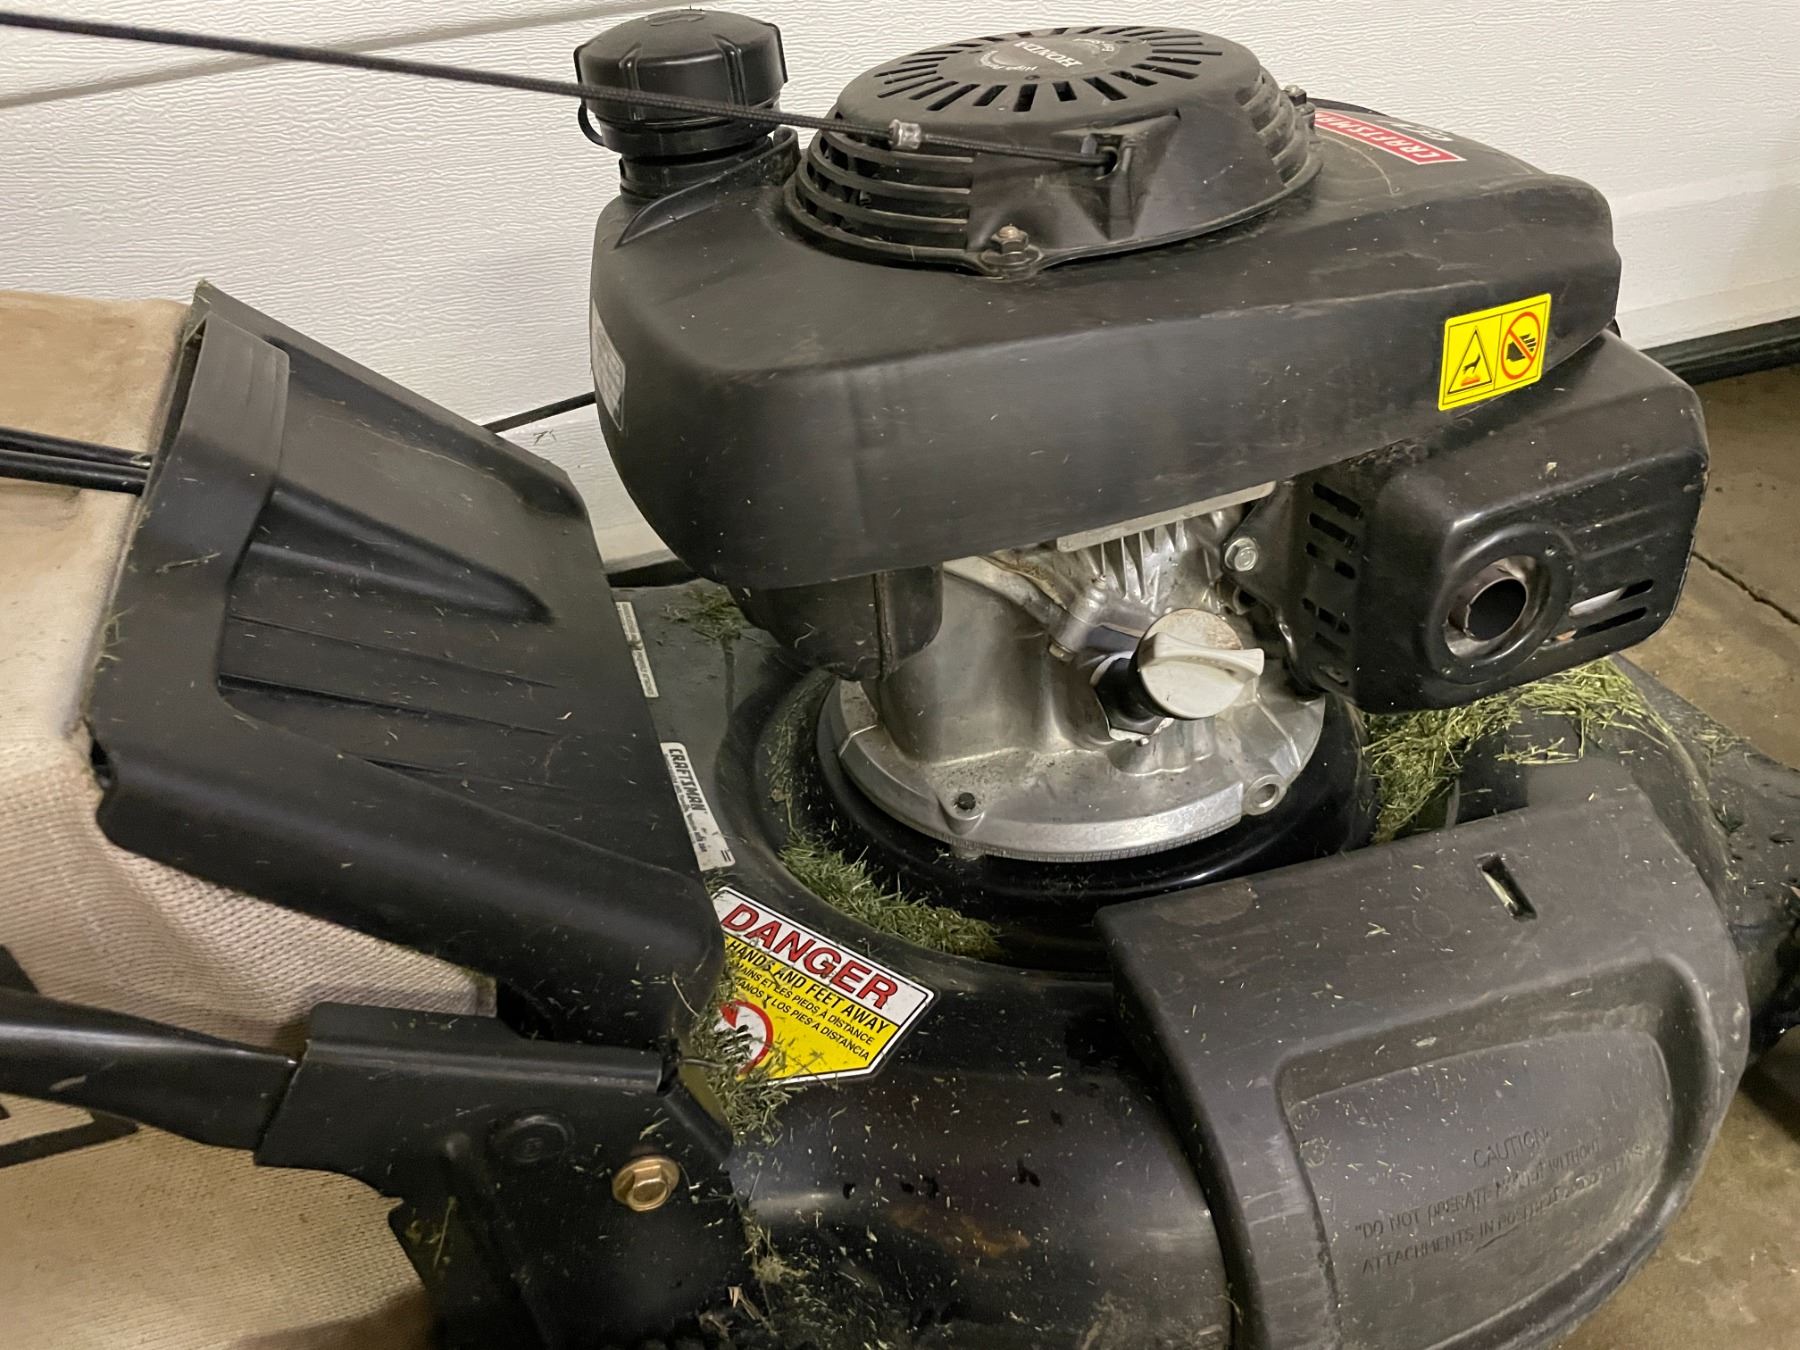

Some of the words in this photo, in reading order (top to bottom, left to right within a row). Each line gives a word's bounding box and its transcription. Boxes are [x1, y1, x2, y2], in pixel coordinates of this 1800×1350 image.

[1315, 112, 1441, 158] CRAFTSMA
[668, 747, 706, 812] CRAFTSMAN
[721, 903, 899, 1010] DANGER
[726, 940, 774, 971] HANDS
[774, 969, 806, 989] AND
[805, 983, 845, 1008] FEET
[841, 1004, 890, 1034] AWAY
[736, 979, 764, 998] ANOS
[771, 998, 792, 1013] LOS
[790, 1009, 813, 1026] PIES
[811, 1022, 821, 1031] A
[820, 1026, 870, 1062] DISTANCIA
[761, 978, 775, 988] ET
[774, 986, 793, 999] LES
[791, 994, 820, 1014] PIEDS
[828, 1014, 875, 1046] DISTANCE
[1362, 1227, 1474, 1274] ATTACHMENTS
[1390, 1211, 1420, 1231] NOT
